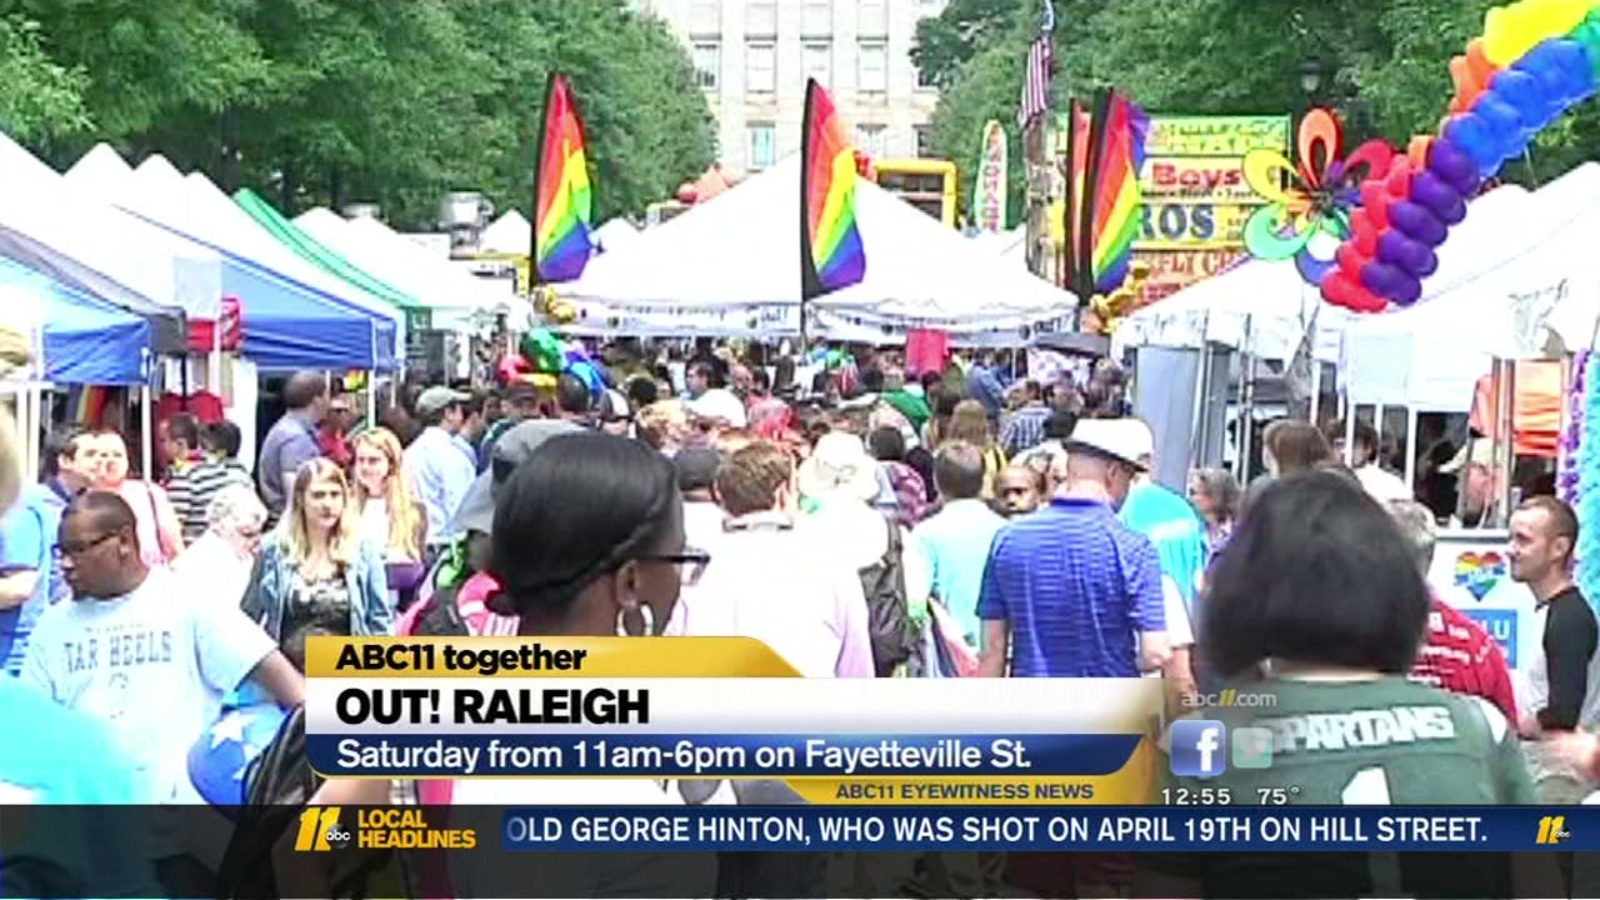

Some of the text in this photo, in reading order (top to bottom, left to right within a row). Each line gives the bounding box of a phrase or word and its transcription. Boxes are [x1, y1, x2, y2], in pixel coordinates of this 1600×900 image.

[1152, 161, 1241, 187] Boys
[64, 630, 172, 673] TAR HEELS
[1254, 706, 1455, 753] SPARTANS
